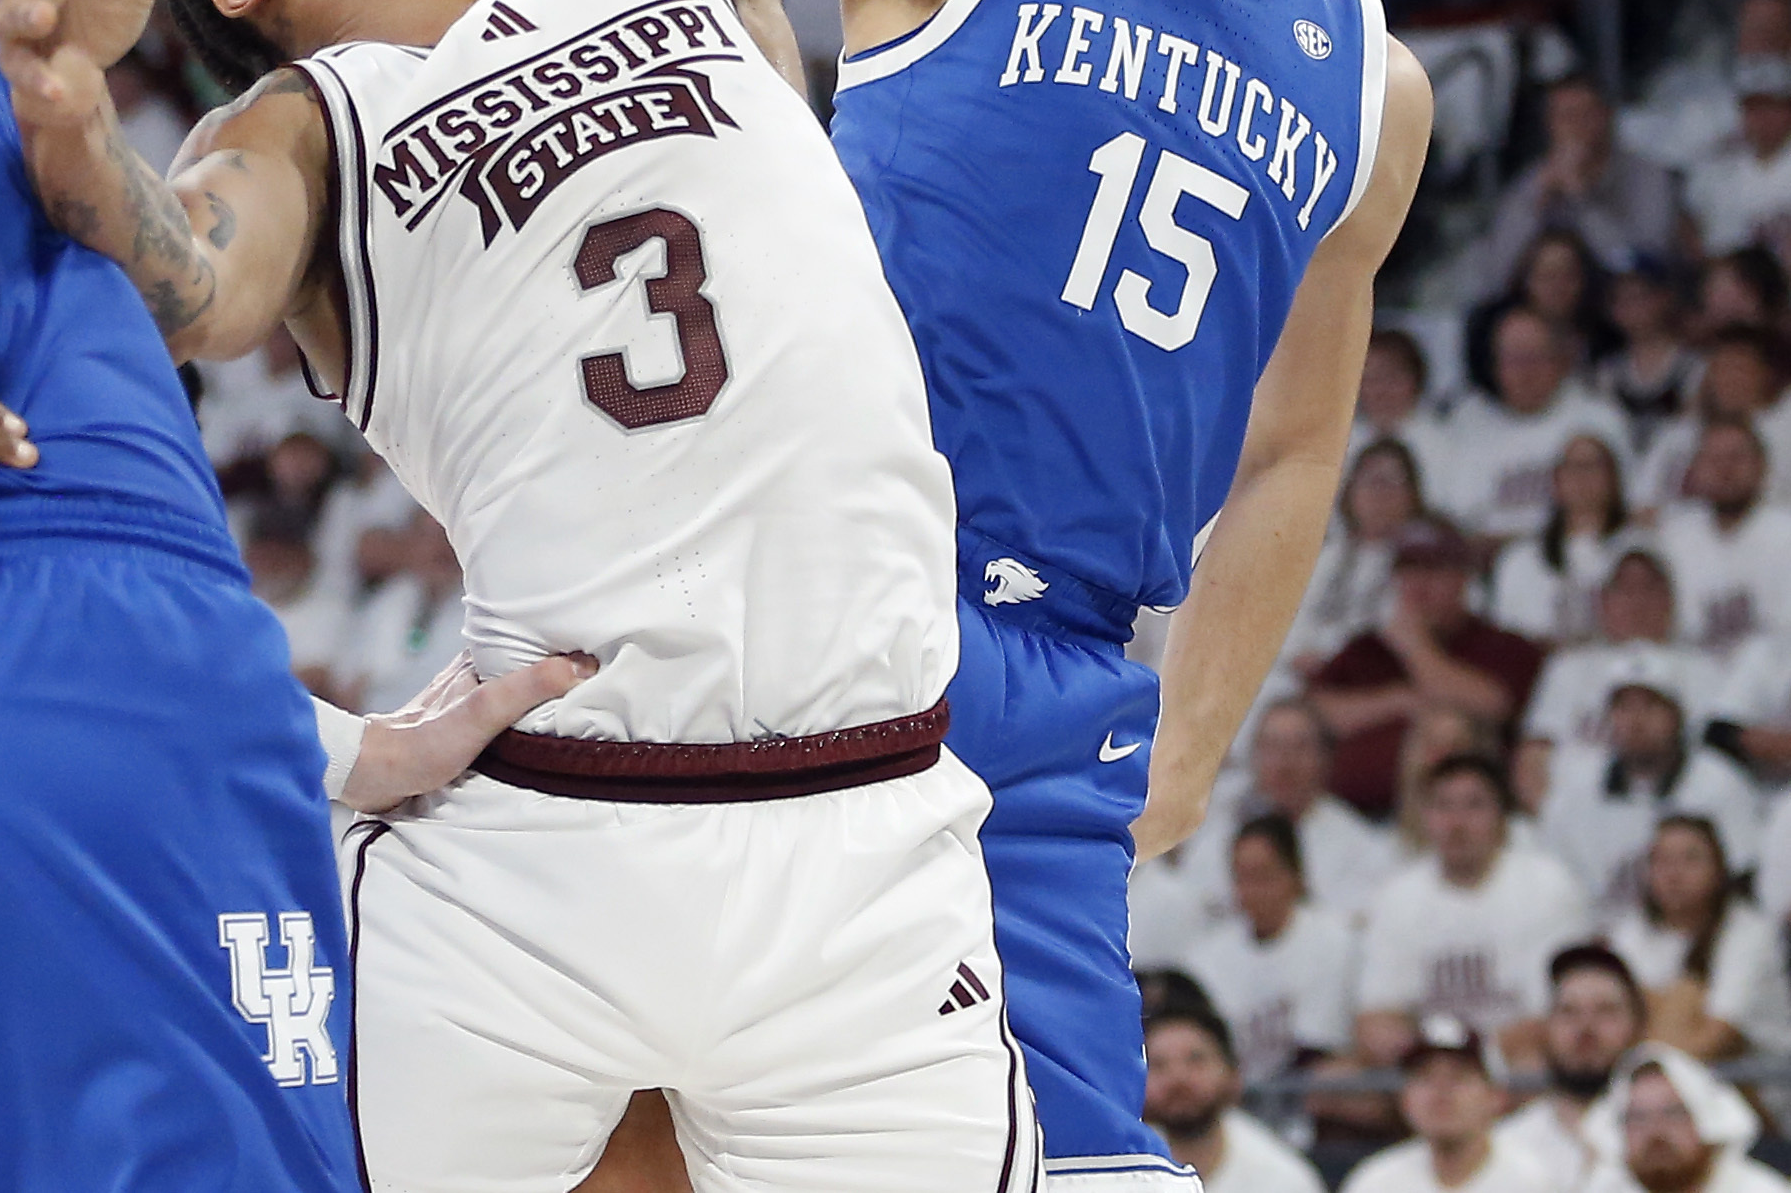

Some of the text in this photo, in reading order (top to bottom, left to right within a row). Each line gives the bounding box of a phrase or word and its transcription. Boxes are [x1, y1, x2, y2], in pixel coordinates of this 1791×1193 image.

[373, 4, 737, 218] MISSISSIPPI
[507, 90, 691, 201] STATE
[998, 3, 1338, 231] KENTUCKY
[1296, 21, 1331, 57] SEC
[571, 205, 733, 432] 3
[1060, 130, 1251, 353] 15
[218, 911, 339, 1088] UK
